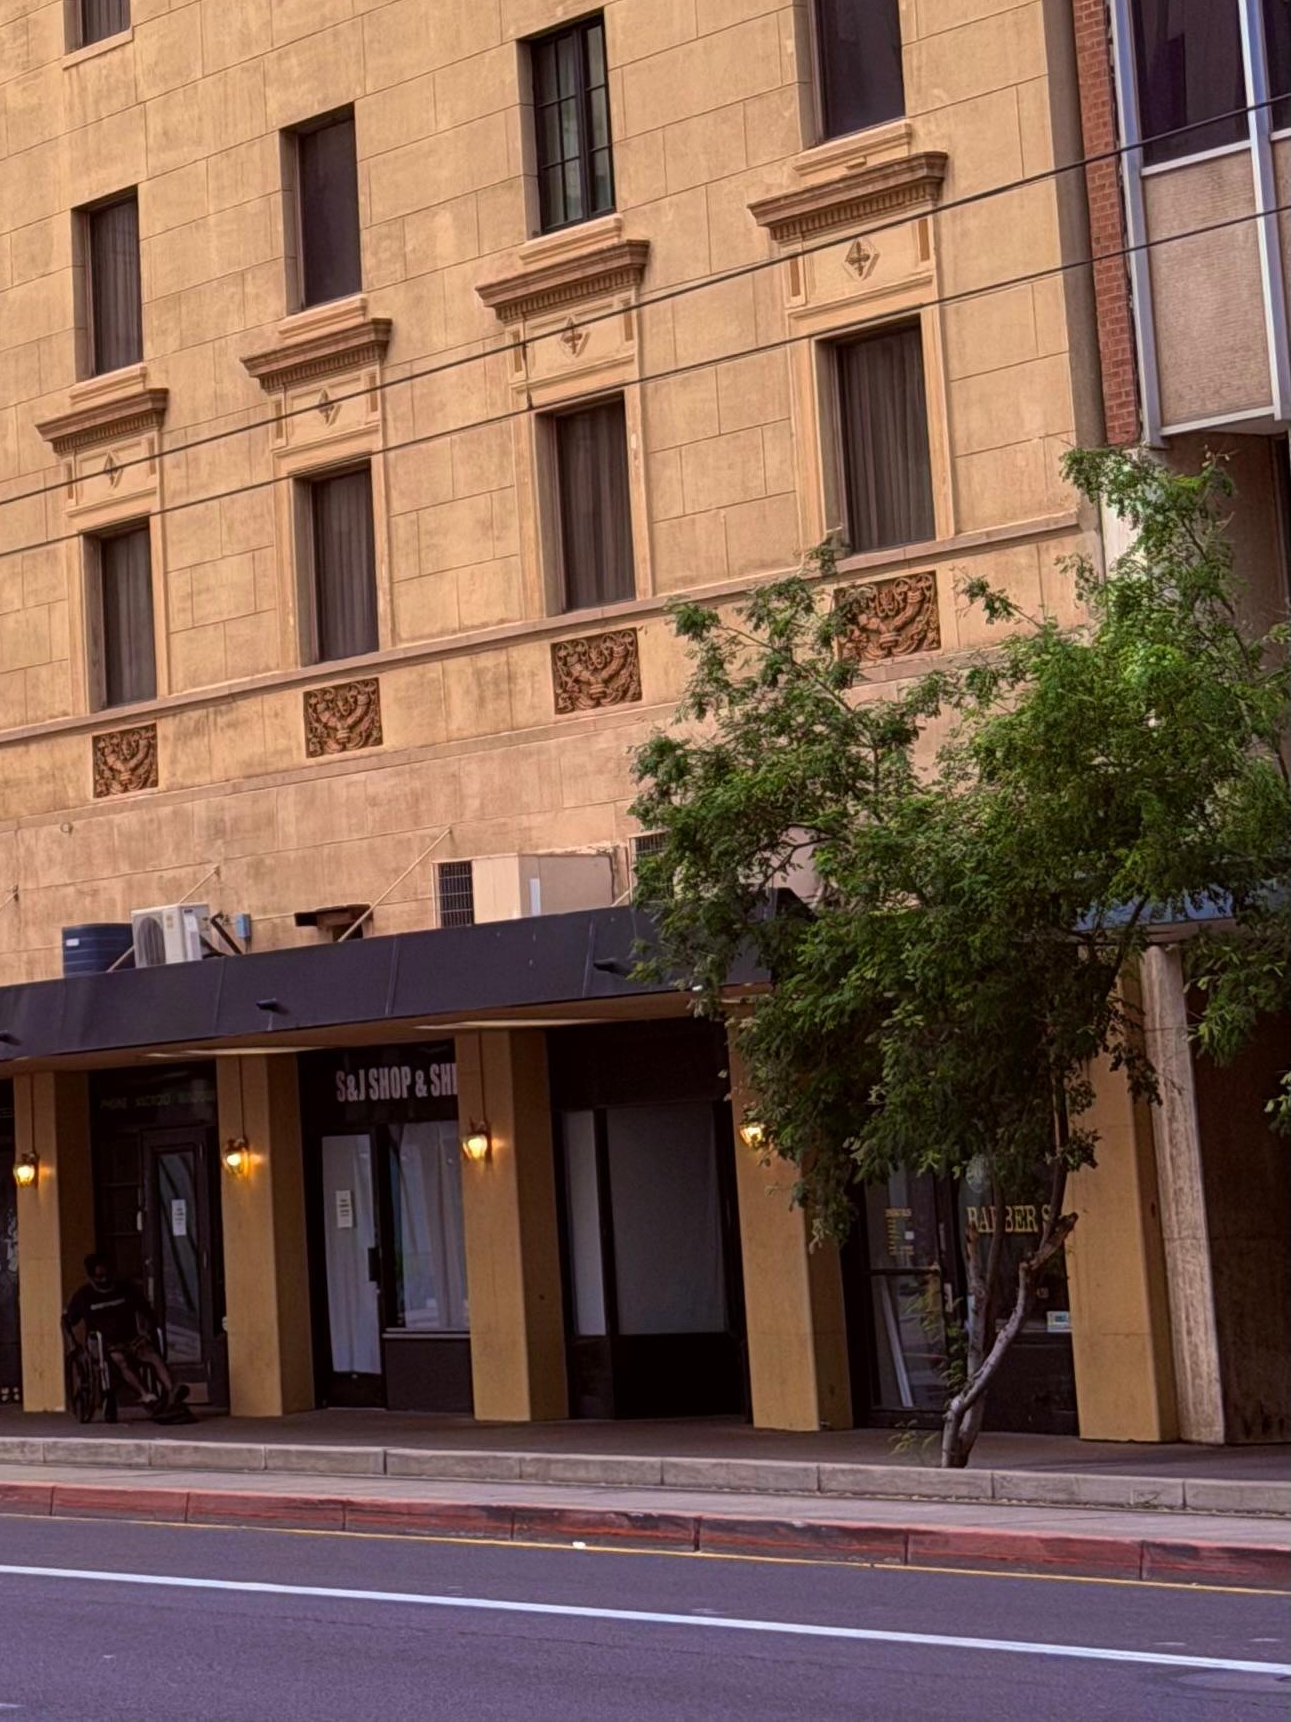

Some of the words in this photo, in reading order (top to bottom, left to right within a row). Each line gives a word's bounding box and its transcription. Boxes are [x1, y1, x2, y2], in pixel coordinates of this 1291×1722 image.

[335, 1069, 366, 1102] S&J
[368, 1065, 412, 1101] SHOP
[414, 1069, 428, 1098] &
